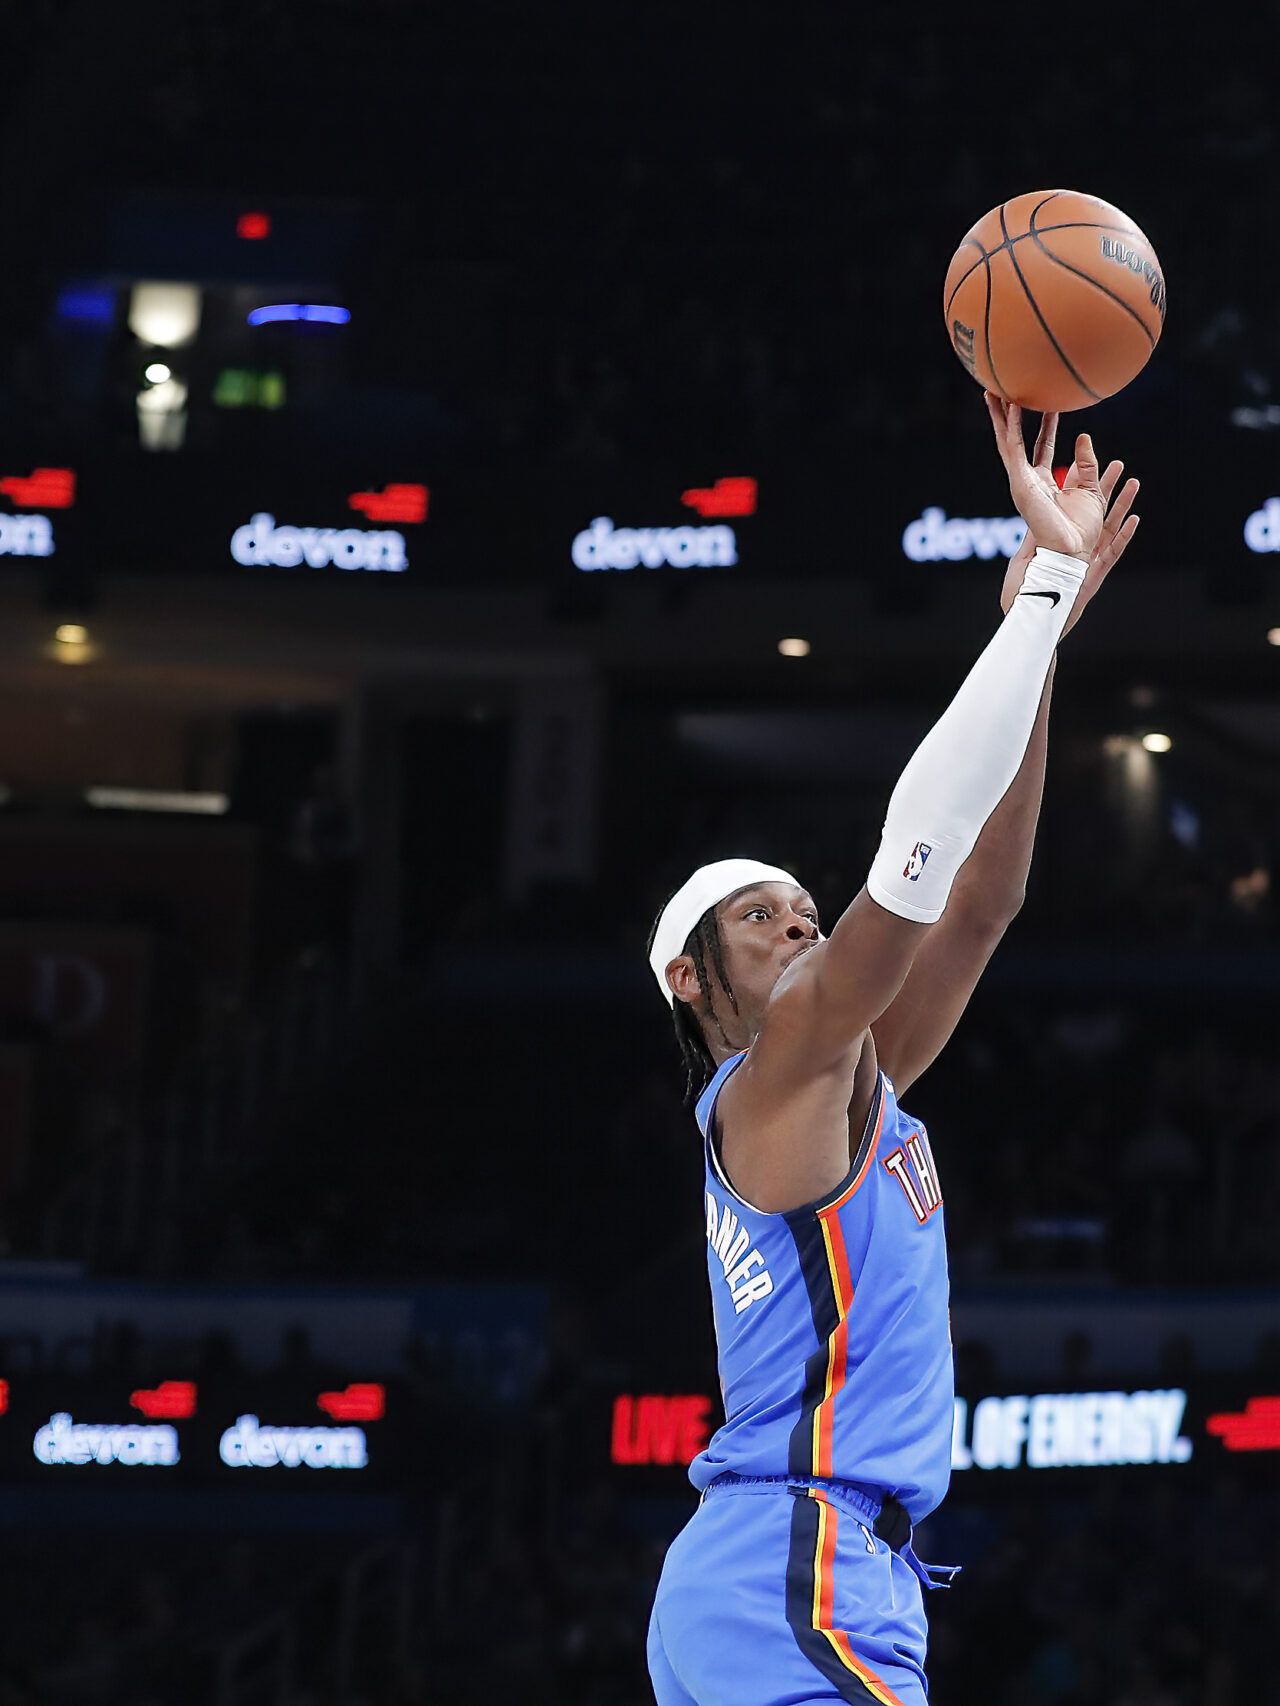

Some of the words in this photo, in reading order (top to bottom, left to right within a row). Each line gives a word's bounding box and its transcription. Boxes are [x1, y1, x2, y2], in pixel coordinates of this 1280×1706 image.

[230, 512, 409, 573] devon
[572, 515, 738, 571] devon
[902, 506, 1028, 561] devo
[33, 1412, 180, 1466] devon
[219, 1413, 369, 1469] devon
[611, 1394, 711, 1466] LIVE
